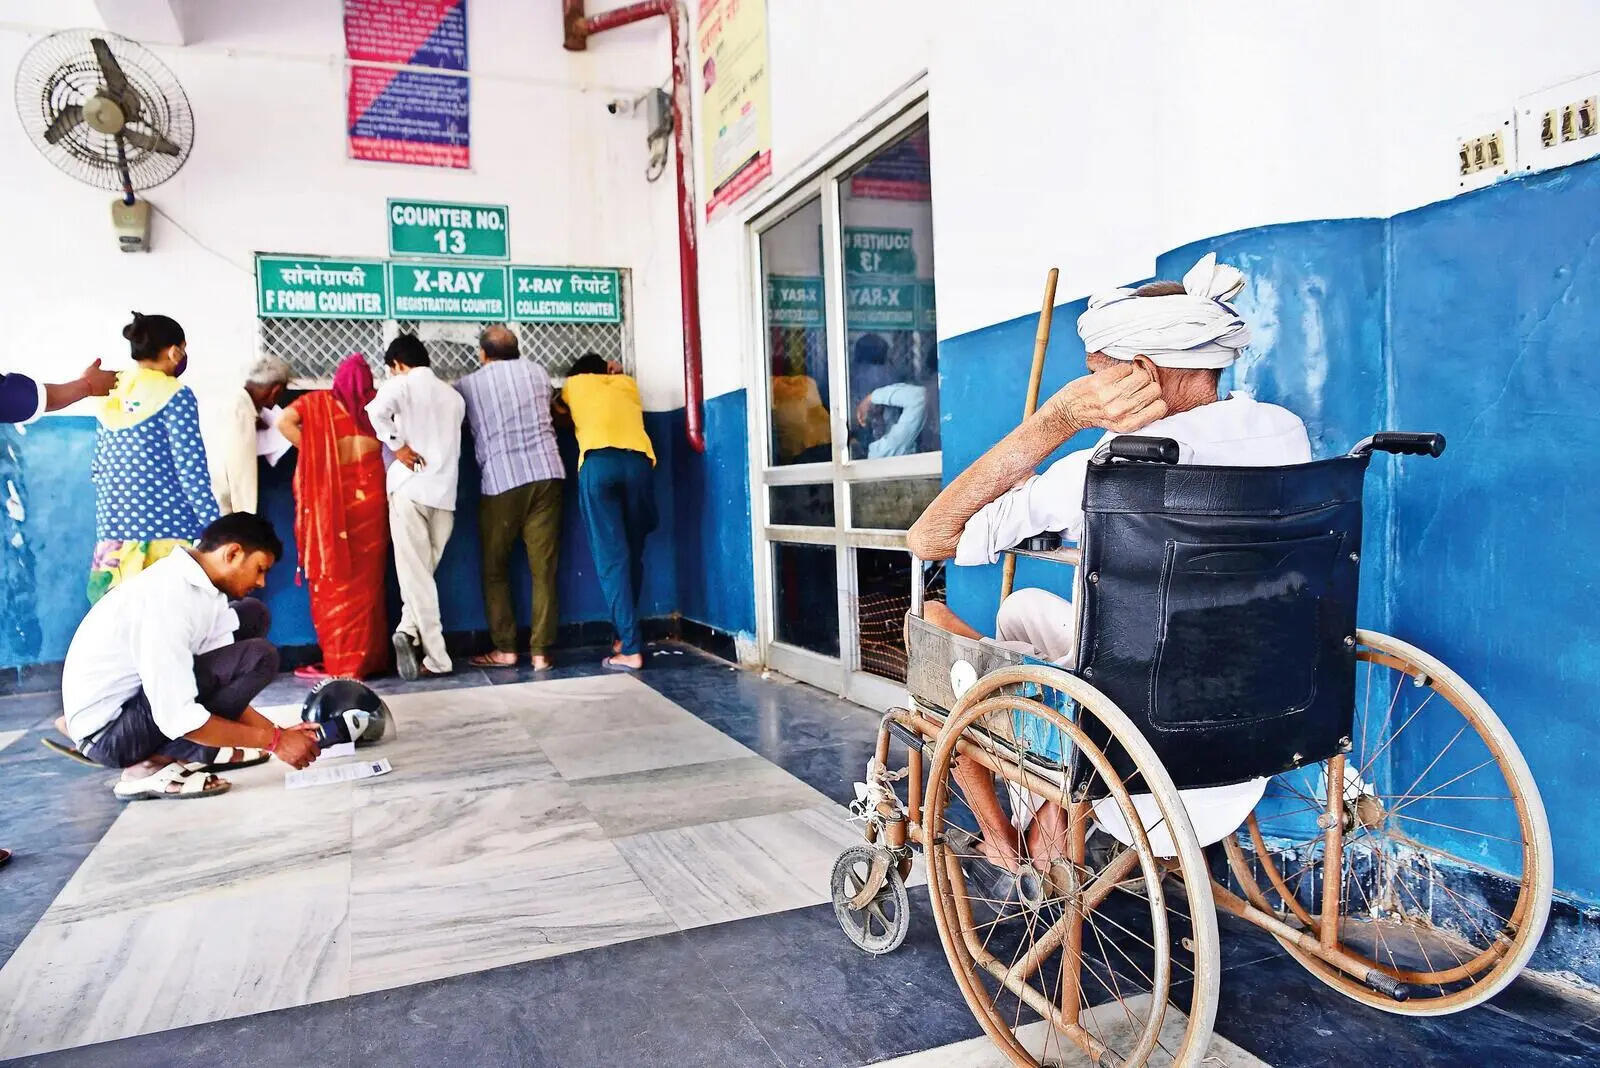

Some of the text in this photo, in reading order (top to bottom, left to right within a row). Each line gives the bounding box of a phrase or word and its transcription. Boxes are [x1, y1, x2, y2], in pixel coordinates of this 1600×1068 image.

[392, 205, 504, 230] COUNTER NO.
[434, 229, 466, 254] 13
[280, 263, 367, 287] सोनोग्राफी
[413, 269, 485, 294] X-RAY
[518, 274, 611, 295] X-RAY रिपोर्ट
[265, 289, 382, 313] F FORM COUNTER
[396, 296, 503, 314] REGISTRATION COUNTER
[516, 300, 615, 317] COLLECTION COUNTER
